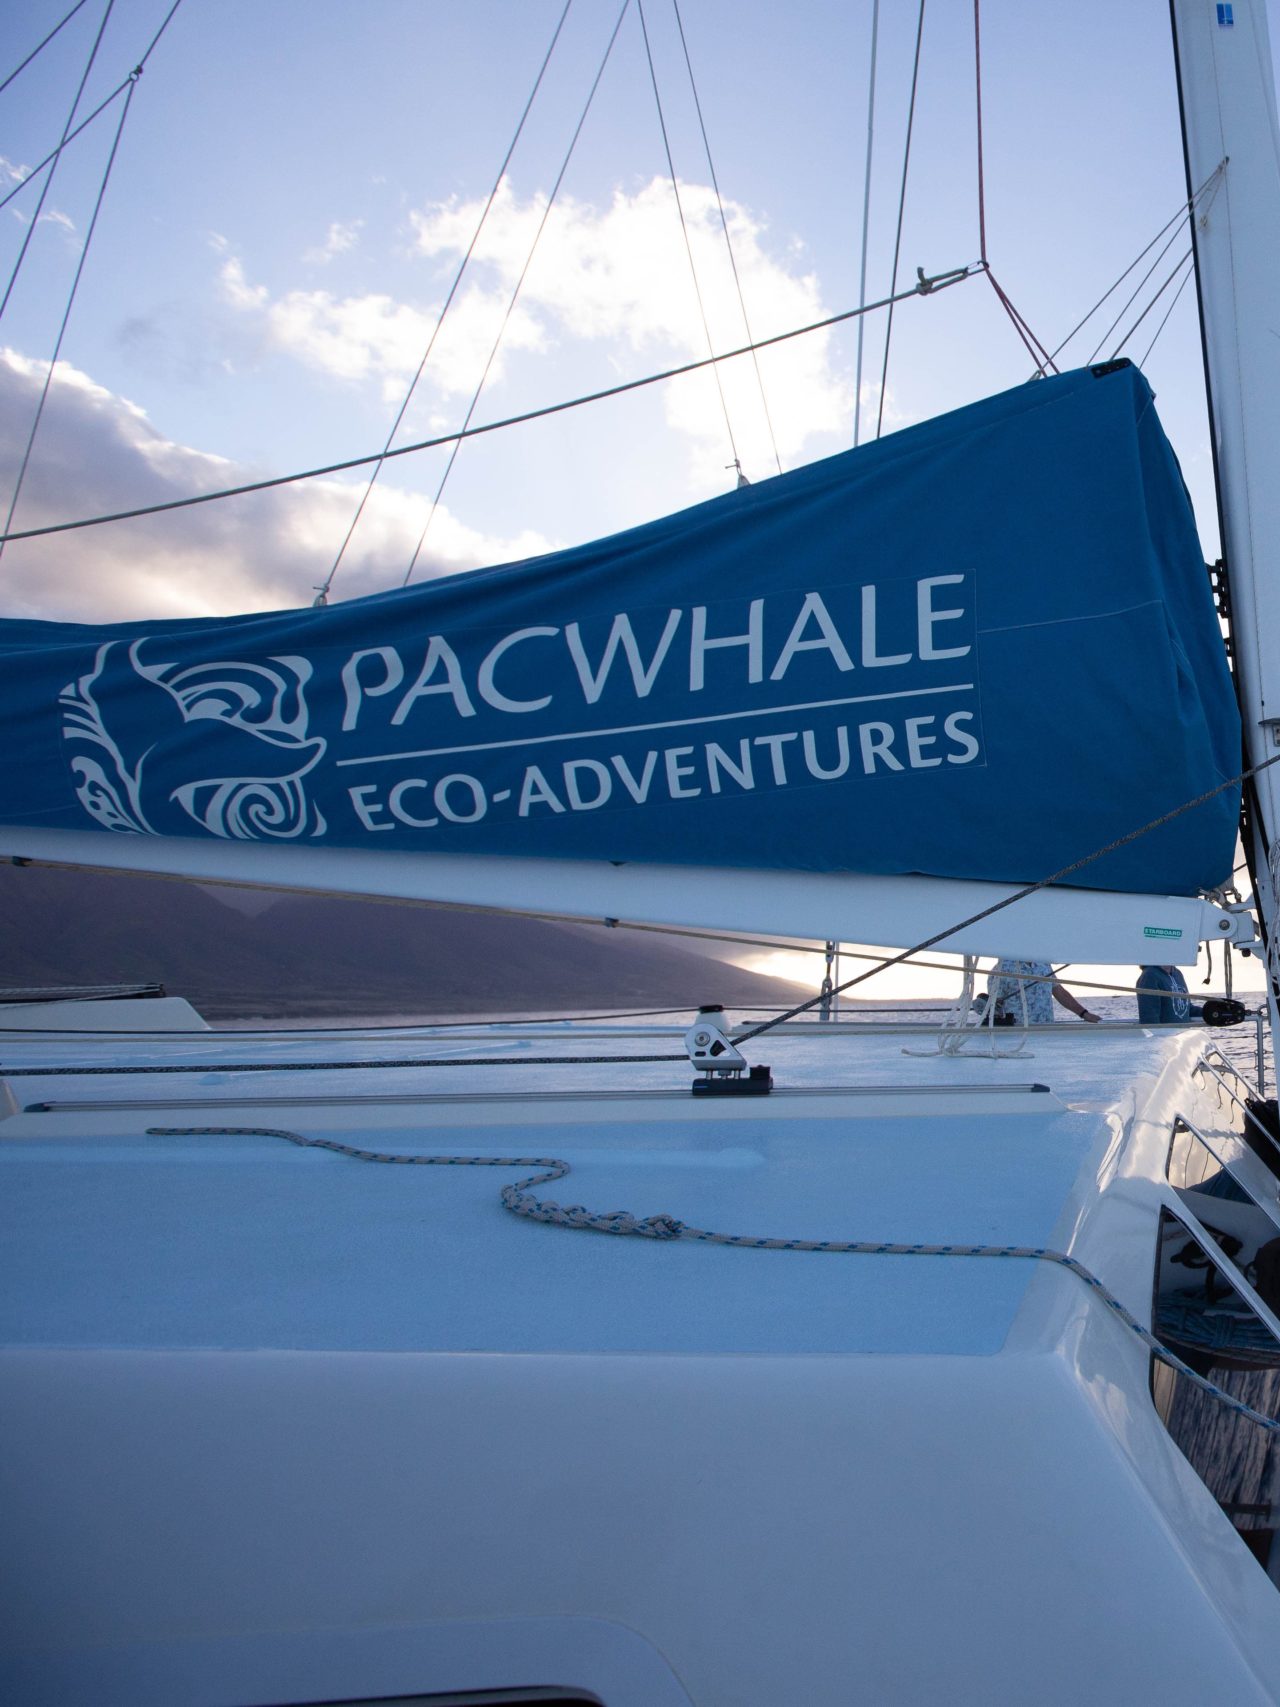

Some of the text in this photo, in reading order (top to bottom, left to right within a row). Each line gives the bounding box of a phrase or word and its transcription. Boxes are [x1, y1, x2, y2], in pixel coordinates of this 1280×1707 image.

[341, 573, 972, 732] PACWHALE
[347, 710, 980, 831] ECO-ADVENTURES
[1144, 928, 1181, 937] STARBOARD
